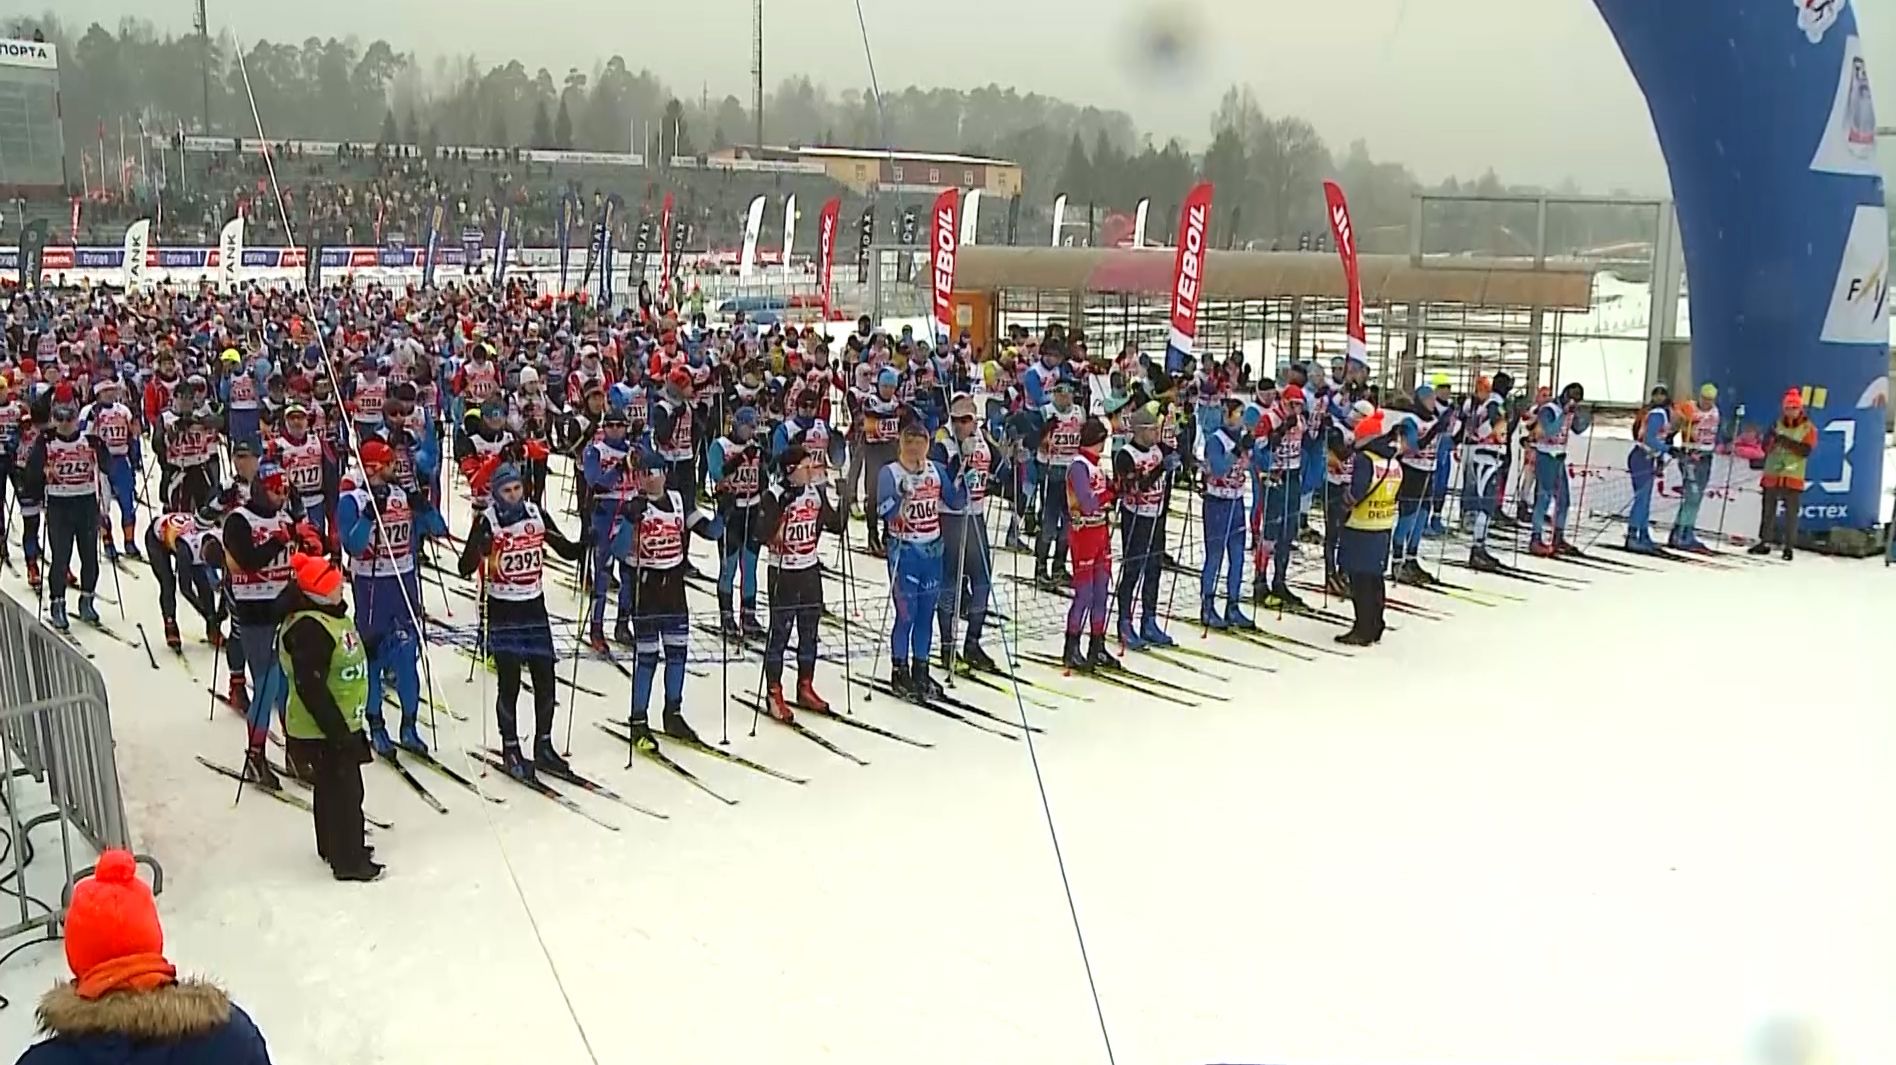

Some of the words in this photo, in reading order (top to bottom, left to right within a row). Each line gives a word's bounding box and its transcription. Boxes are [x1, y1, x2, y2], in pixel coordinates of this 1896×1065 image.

[935, 207, 955, 307] TEBOIL
[1175, 203, 1206, 320] TEBOIL
[56, 461, 90, 475] 2242
[292, 466, 320, 484] 2127
[503, 550, 541, 573] 2393
